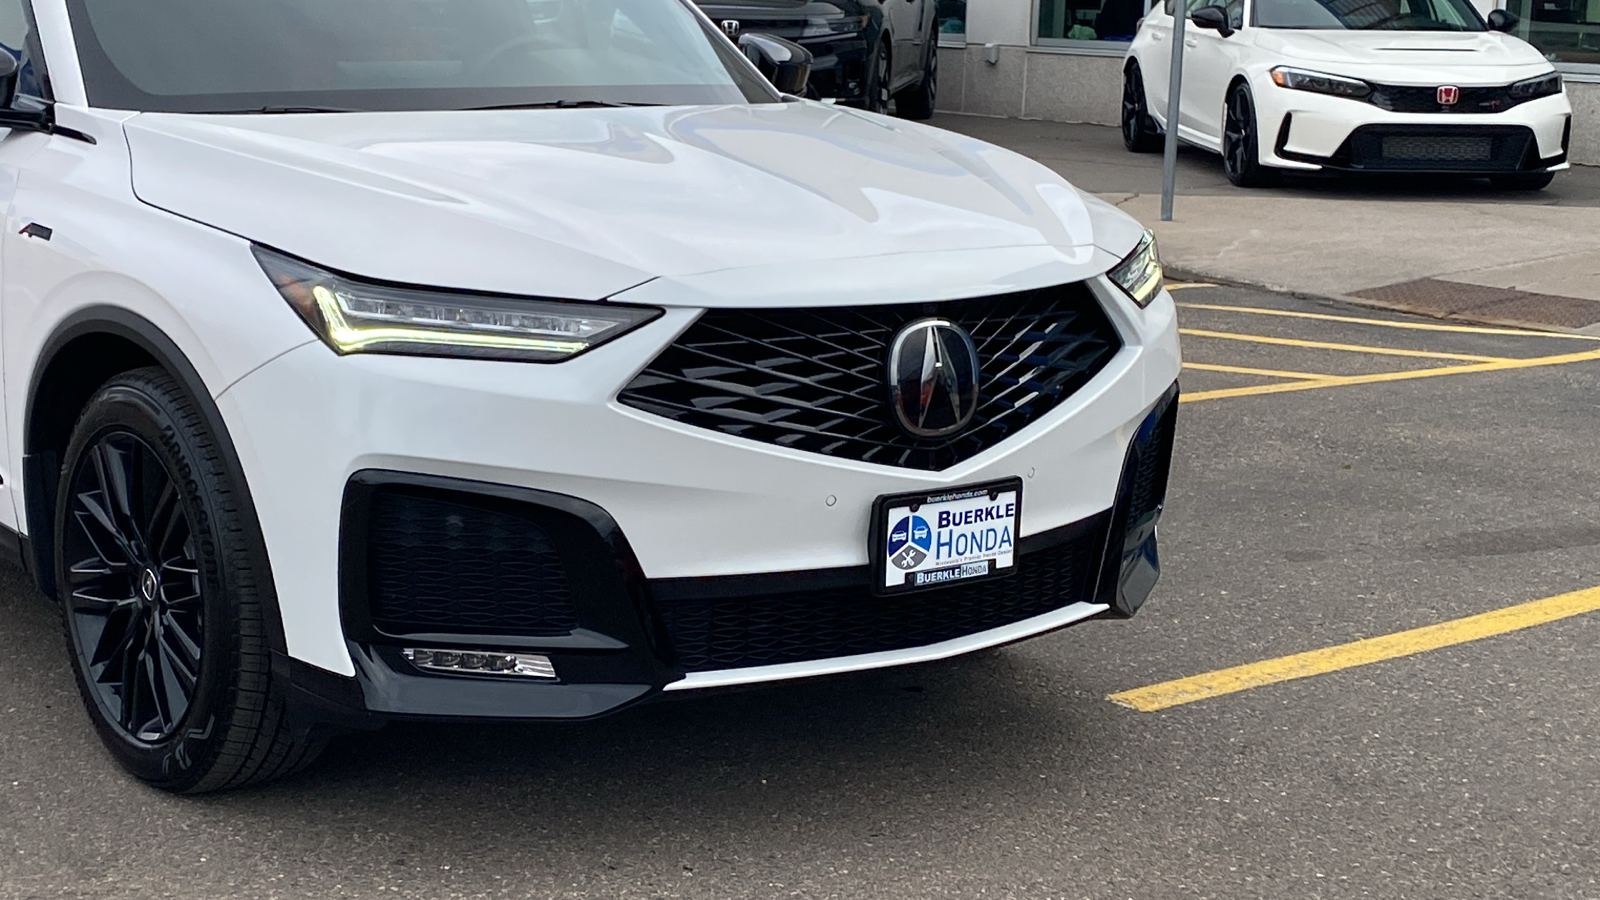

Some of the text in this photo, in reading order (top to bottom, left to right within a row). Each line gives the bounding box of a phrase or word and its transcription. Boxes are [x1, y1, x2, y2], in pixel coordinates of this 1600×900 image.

[937, 503, 1015, 529] BUERKLE
[936, 525, 1012, 560] HONDA
[916, 564, 987, 584] BUERKLE HONDA
